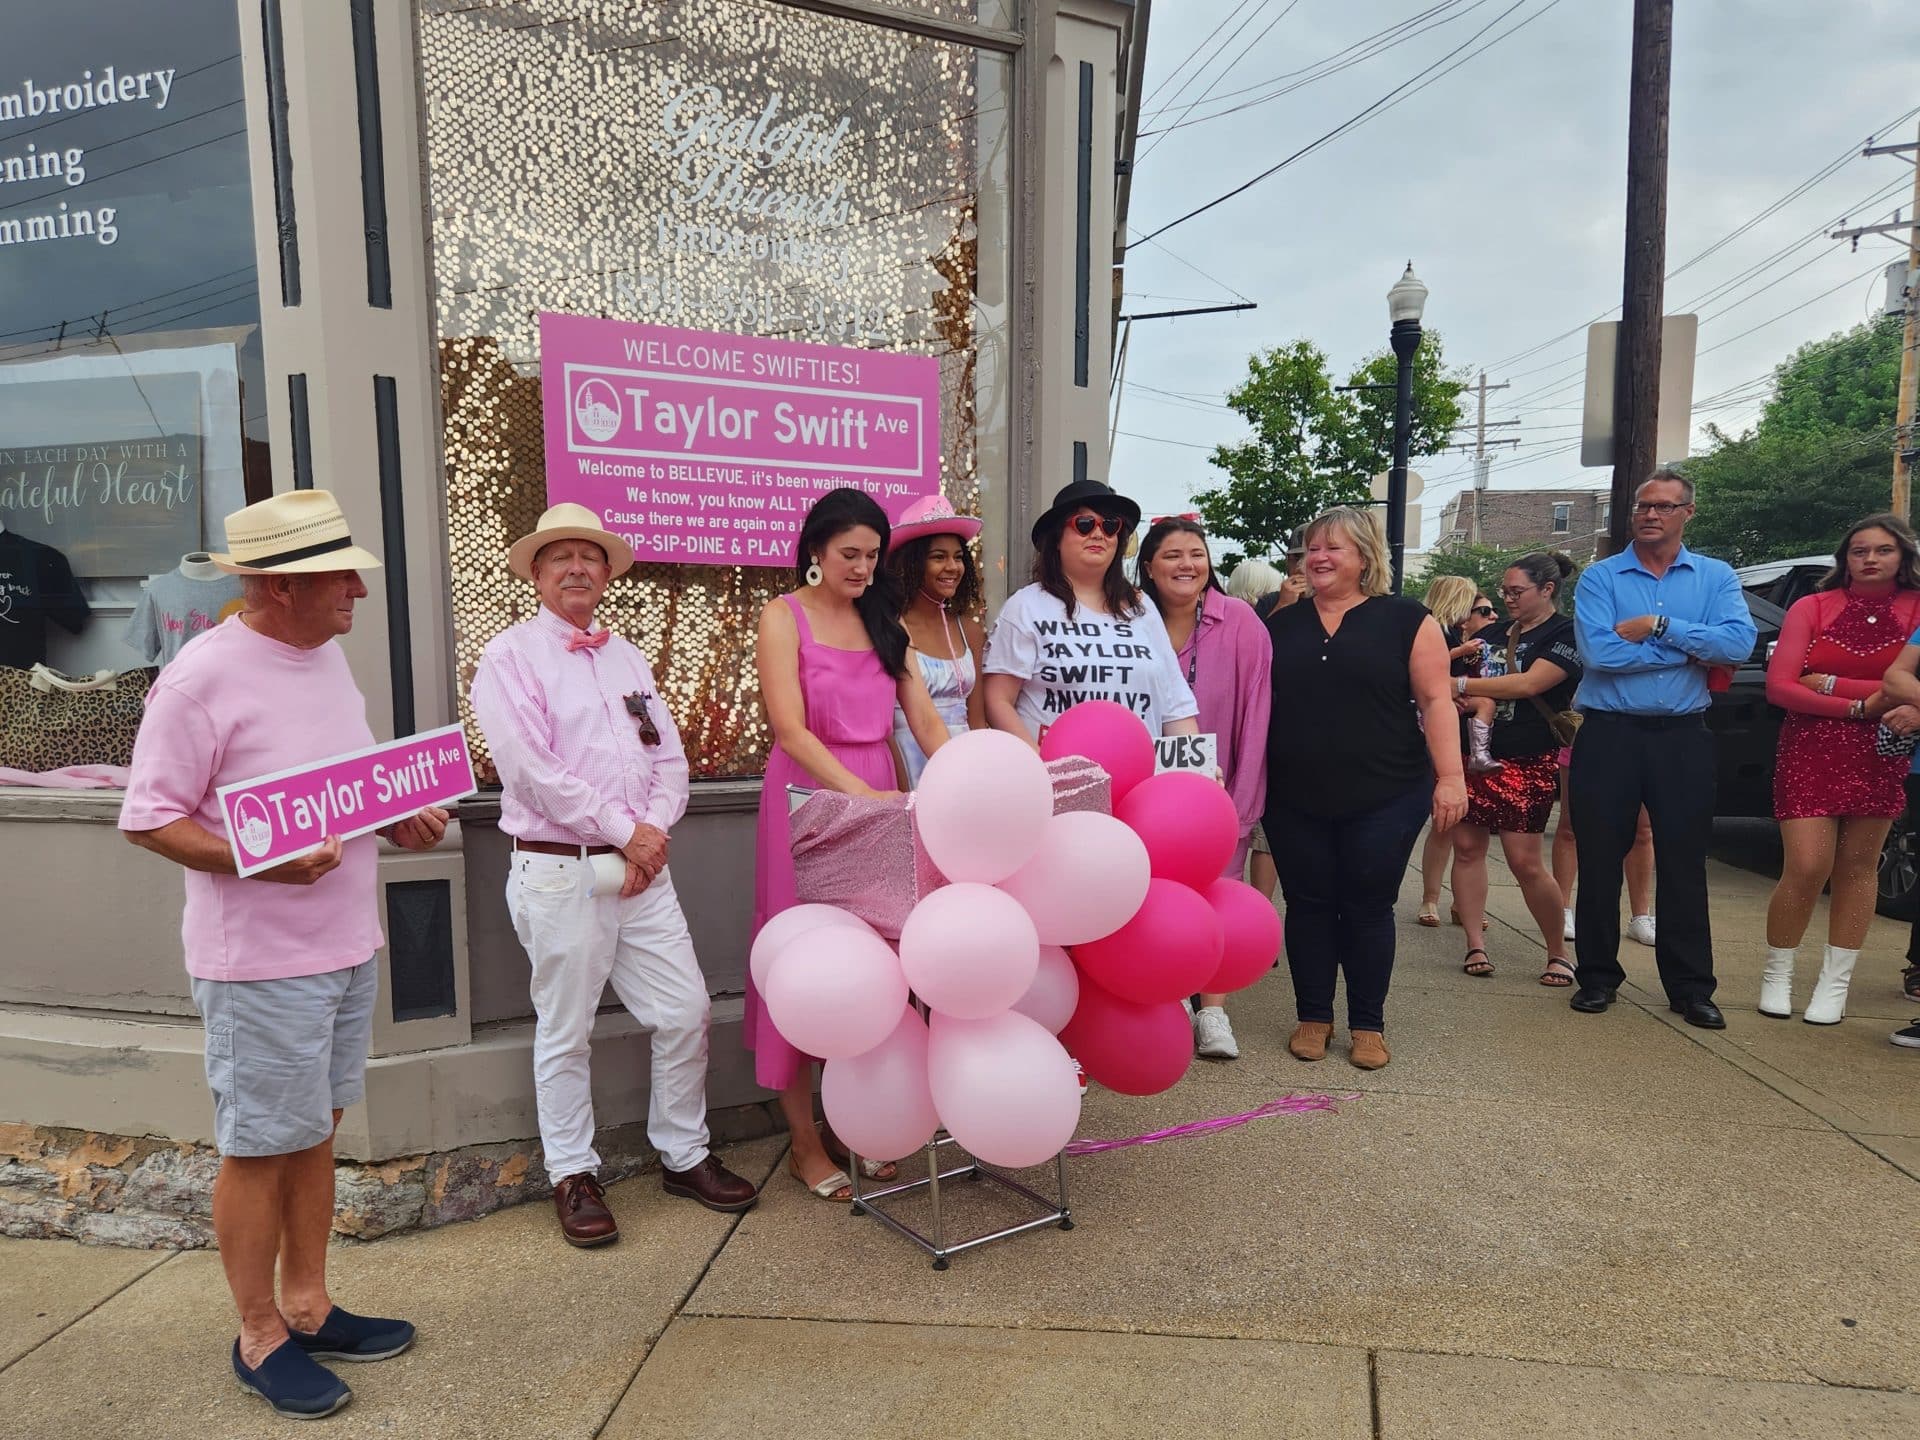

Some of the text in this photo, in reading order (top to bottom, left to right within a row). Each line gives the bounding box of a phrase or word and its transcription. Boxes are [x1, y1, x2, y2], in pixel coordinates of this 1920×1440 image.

[652, 80, 851, 169] Grateful
[0, 143, 86, 186] ning
[670, 150, 851, 227] Threads
[623, 338, 861, 386] WELCOME SWIFTIES!
[625, 387, 909, 450] Taylor Swift Ave
[24, 447, 68, 464] EACH
[77, 446, 110, 462] DAY
[120, 443, 168, 459] WITH
[176, 442, 188, 458] A
[92, 461, 194, 510] Heart
[578, 458, 646, 479] Welcome
[650, 464, 665, 480] to
[668, 464, 748, 486] BELLEVUE,
[751, 470, 773, 487] it's
[776, 473, 809, 489] been
[812, 475, 860, 491] waiting
[863, 478, 881, 493] for
[626, 486, 648, 503] We
[651, 489, 695, 507] know,
[698, 494, 725, 511] you
[728, 493, 765, 509] know
[769, 495, 797, 512] ALL
[604, 508, 645, 525] Cause
[649, 511, 683, 527] there
[687, 515, 705, 528] we
[711, 516, 730, 529] are
[733, 518, 767, 534] again
[770, 521, 785, 532] on
[788, 521, 796, 532] a
[617, 532, 793, 556] OP-SIP-DINE & PLAY
[1033, 620, 1134, 638] WHO'S
[1043, 642, 1153, 660] TAYLOR
[1040, 664, 1134, 684] SWIFT
[267, 746, 461, 838] Taylor Swift Ave
